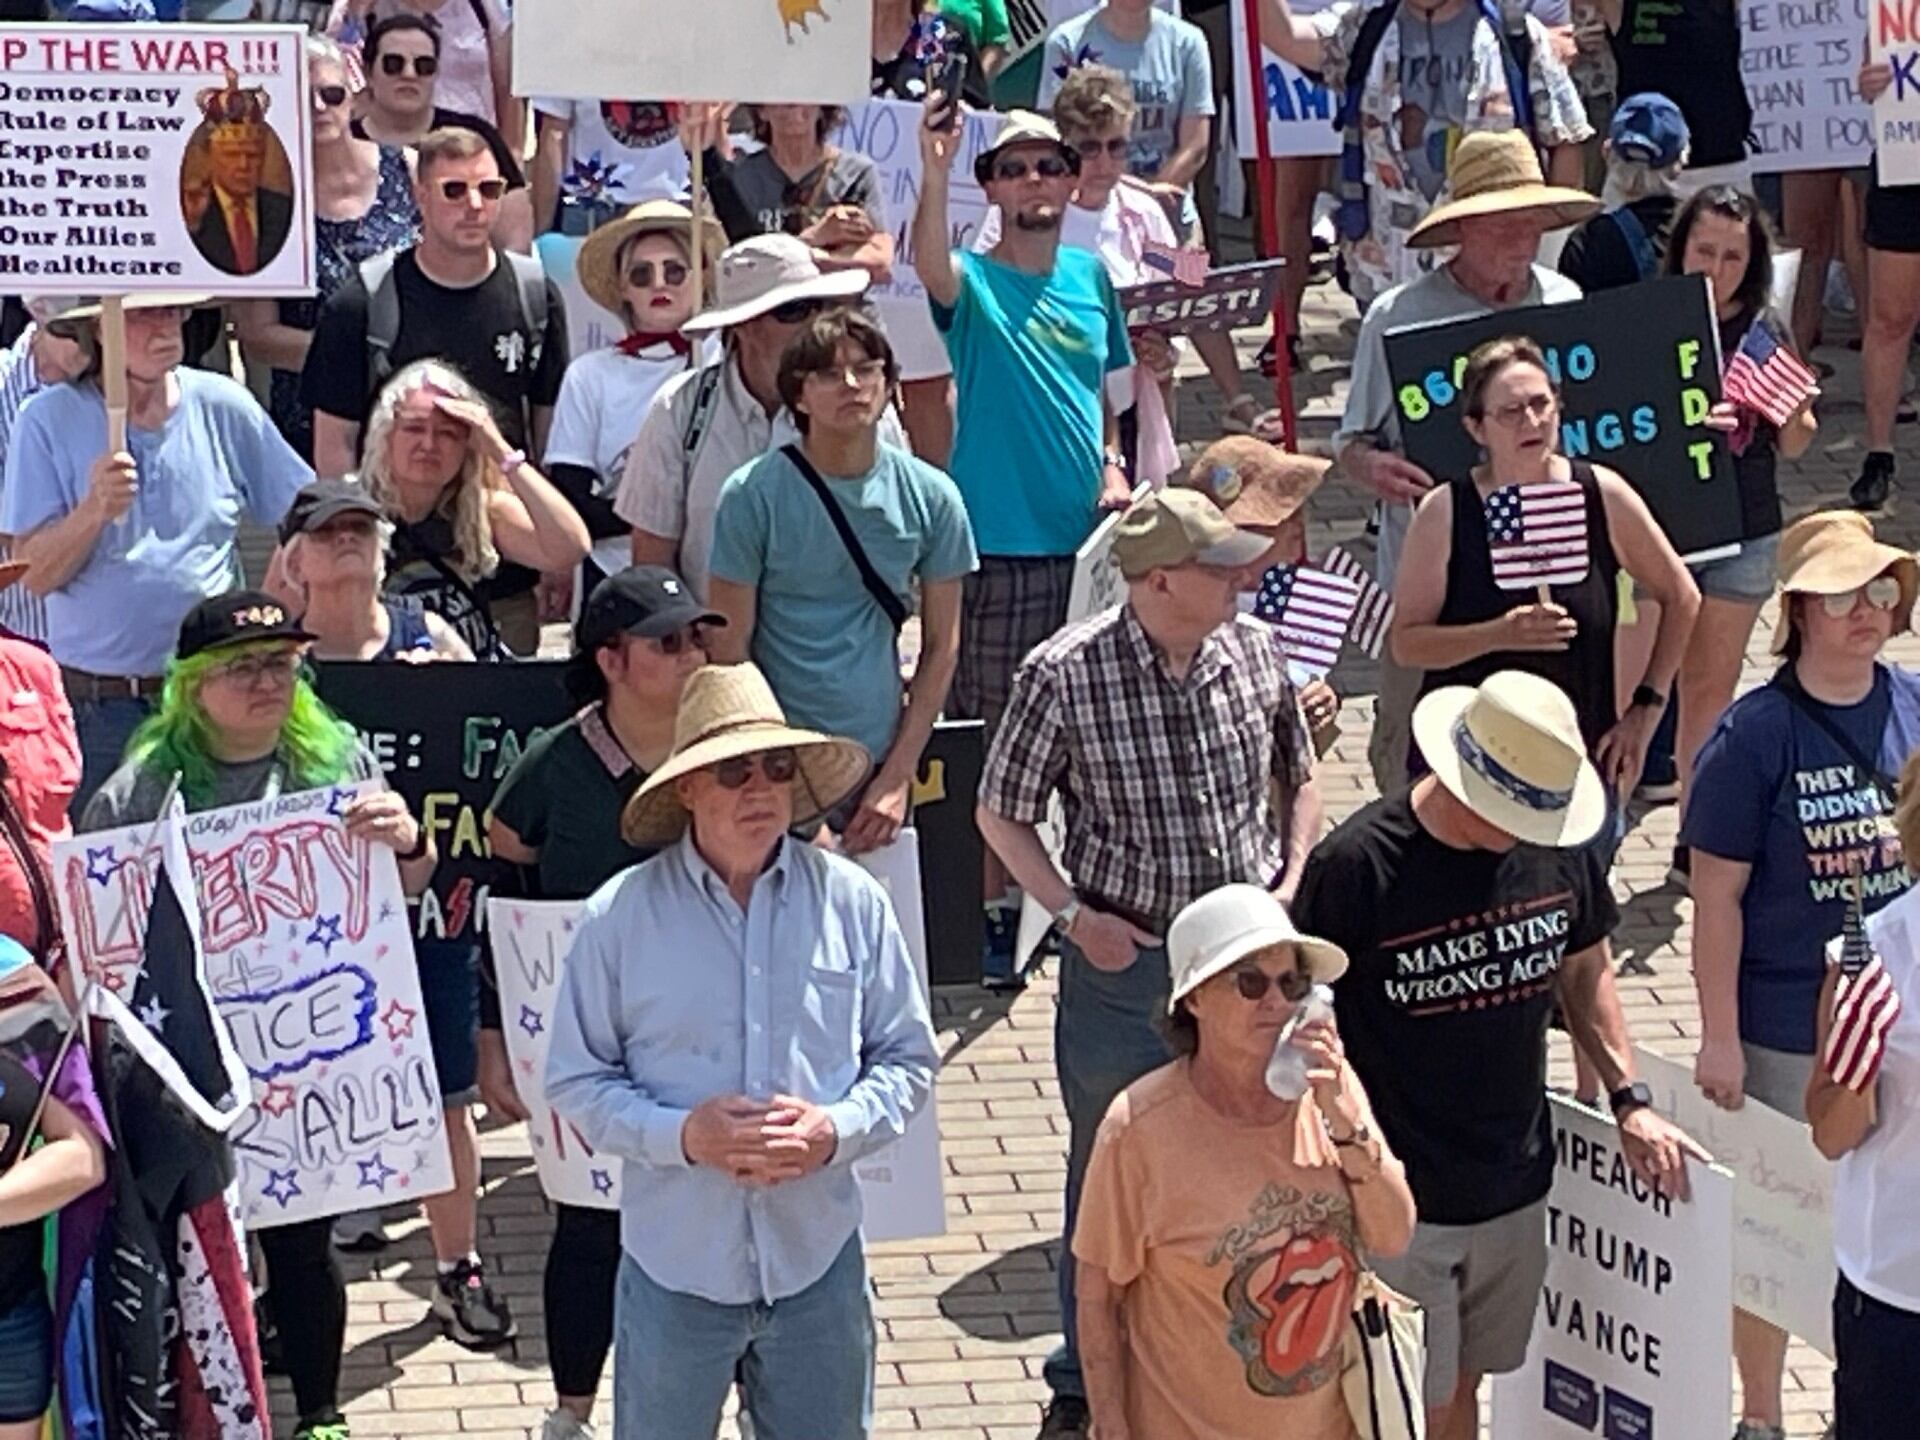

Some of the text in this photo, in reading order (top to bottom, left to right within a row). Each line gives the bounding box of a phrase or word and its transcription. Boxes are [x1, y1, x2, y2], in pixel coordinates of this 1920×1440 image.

[0, 40, 280, 73] P THE WAR !!!
[1815, 38, 1851, 68] IS
[0, 83, 181, 107] Democracy
[0, 111, 184, 131] Rule of Law
[0, 140, 151, 165] Expertise
[1754, 122, 1803, 153] IN
[56, 169, 147, 188] Press
[55, 197, 149, 218] Truth
[0, 226, 156, 246] Our Allies
[0, 255, 182, 276] Healthcare
[1127, 287, 1261, 327] ESIST!
[1562, 405, 1658, 458] NGS
[1794, 765, 1855, 795] THEY
[65, 820, 371, 976] LIERTY
[1809, 866, 1912, 902] WOMEN
[1396, 908, 1570, 975] MAKE LYING
[1384, 962, 1501, 1004] WRONG
[222, 983, 346, 1060] TICE
[1547, 1205, 1673, 1296] TRUMP
[1543, 1285, 1661, 1378] VANCE
